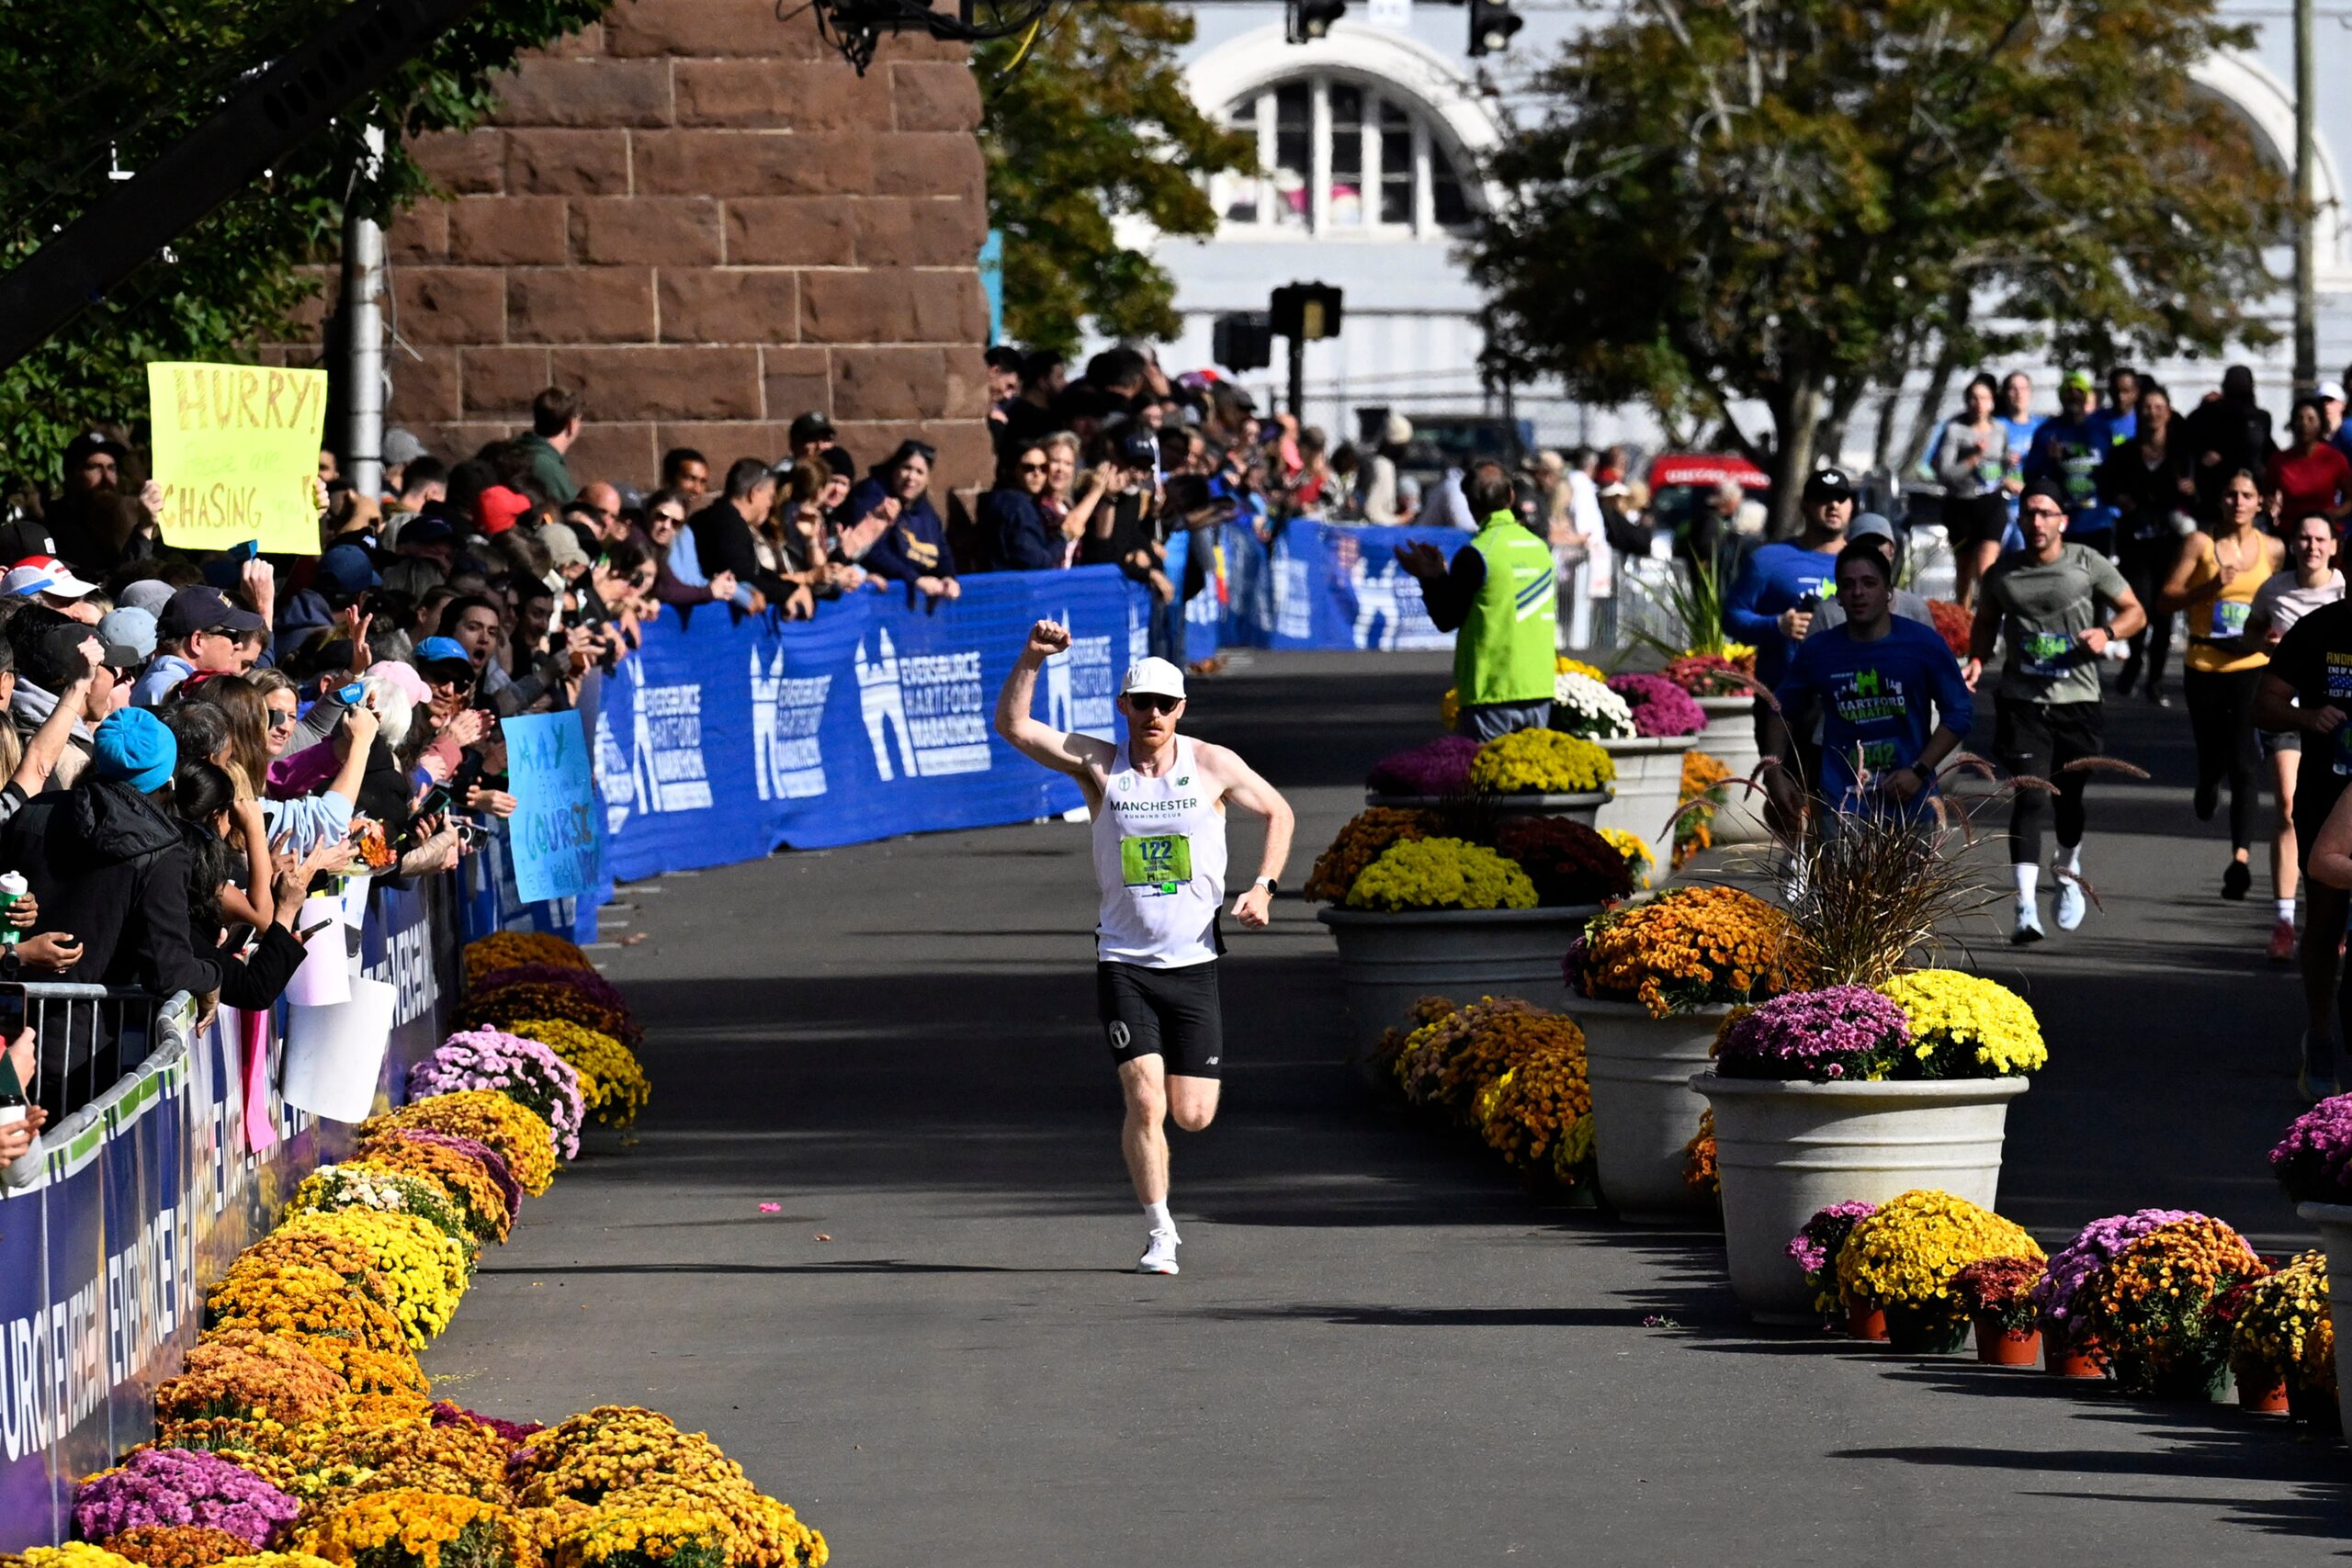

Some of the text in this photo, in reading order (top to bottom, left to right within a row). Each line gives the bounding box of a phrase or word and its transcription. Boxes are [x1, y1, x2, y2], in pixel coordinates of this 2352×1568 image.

[174, 369, 321, 434] HURRY!
[161, 482, 262, 528] CHASING
[516, 723, 564, 772] MAY
[1110, 798, 1197, 811] MANCHESTER
[1139, 840, 1172, 860] 122
